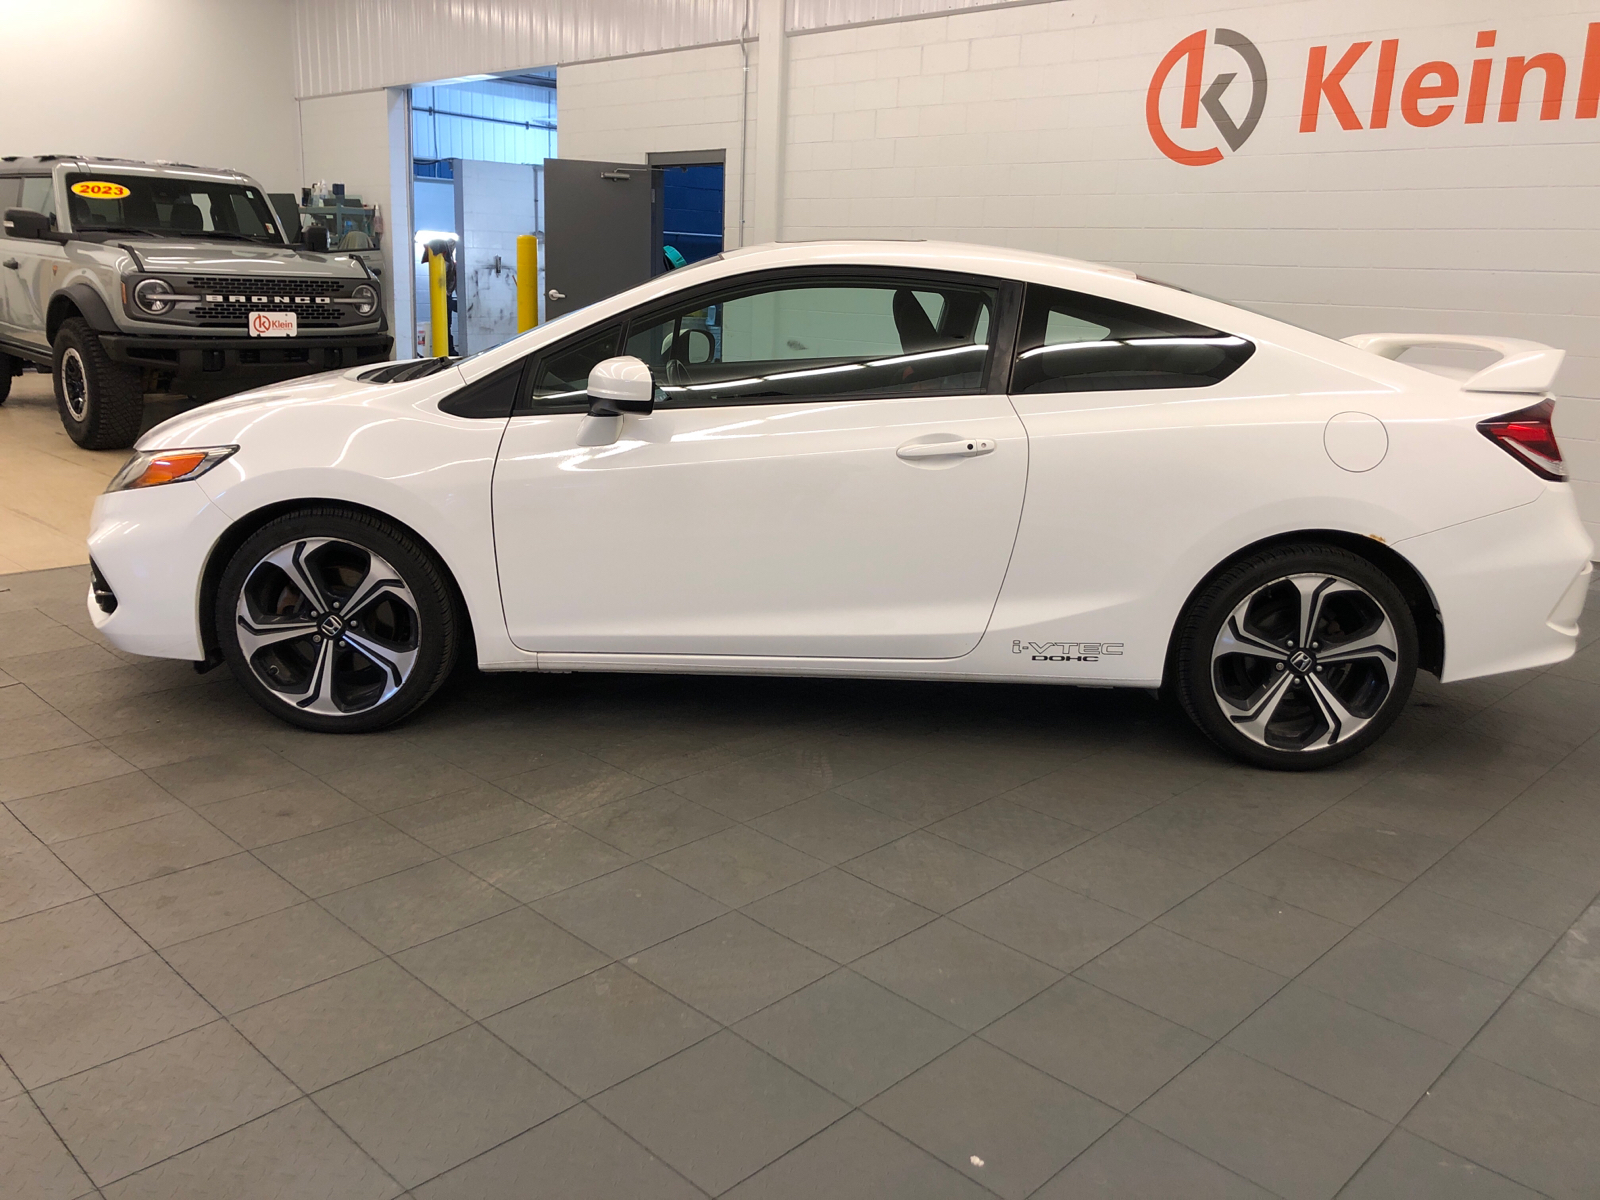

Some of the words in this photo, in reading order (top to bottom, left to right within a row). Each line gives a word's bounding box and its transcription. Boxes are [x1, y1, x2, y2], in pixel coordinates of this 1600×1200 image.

[79, 185, 124, 195] 2023
[206, 295, 330, 303] BRONCO
[271, 320, 293, 328] Klein
[1012, 640, 1124, 655] i-VTEC
